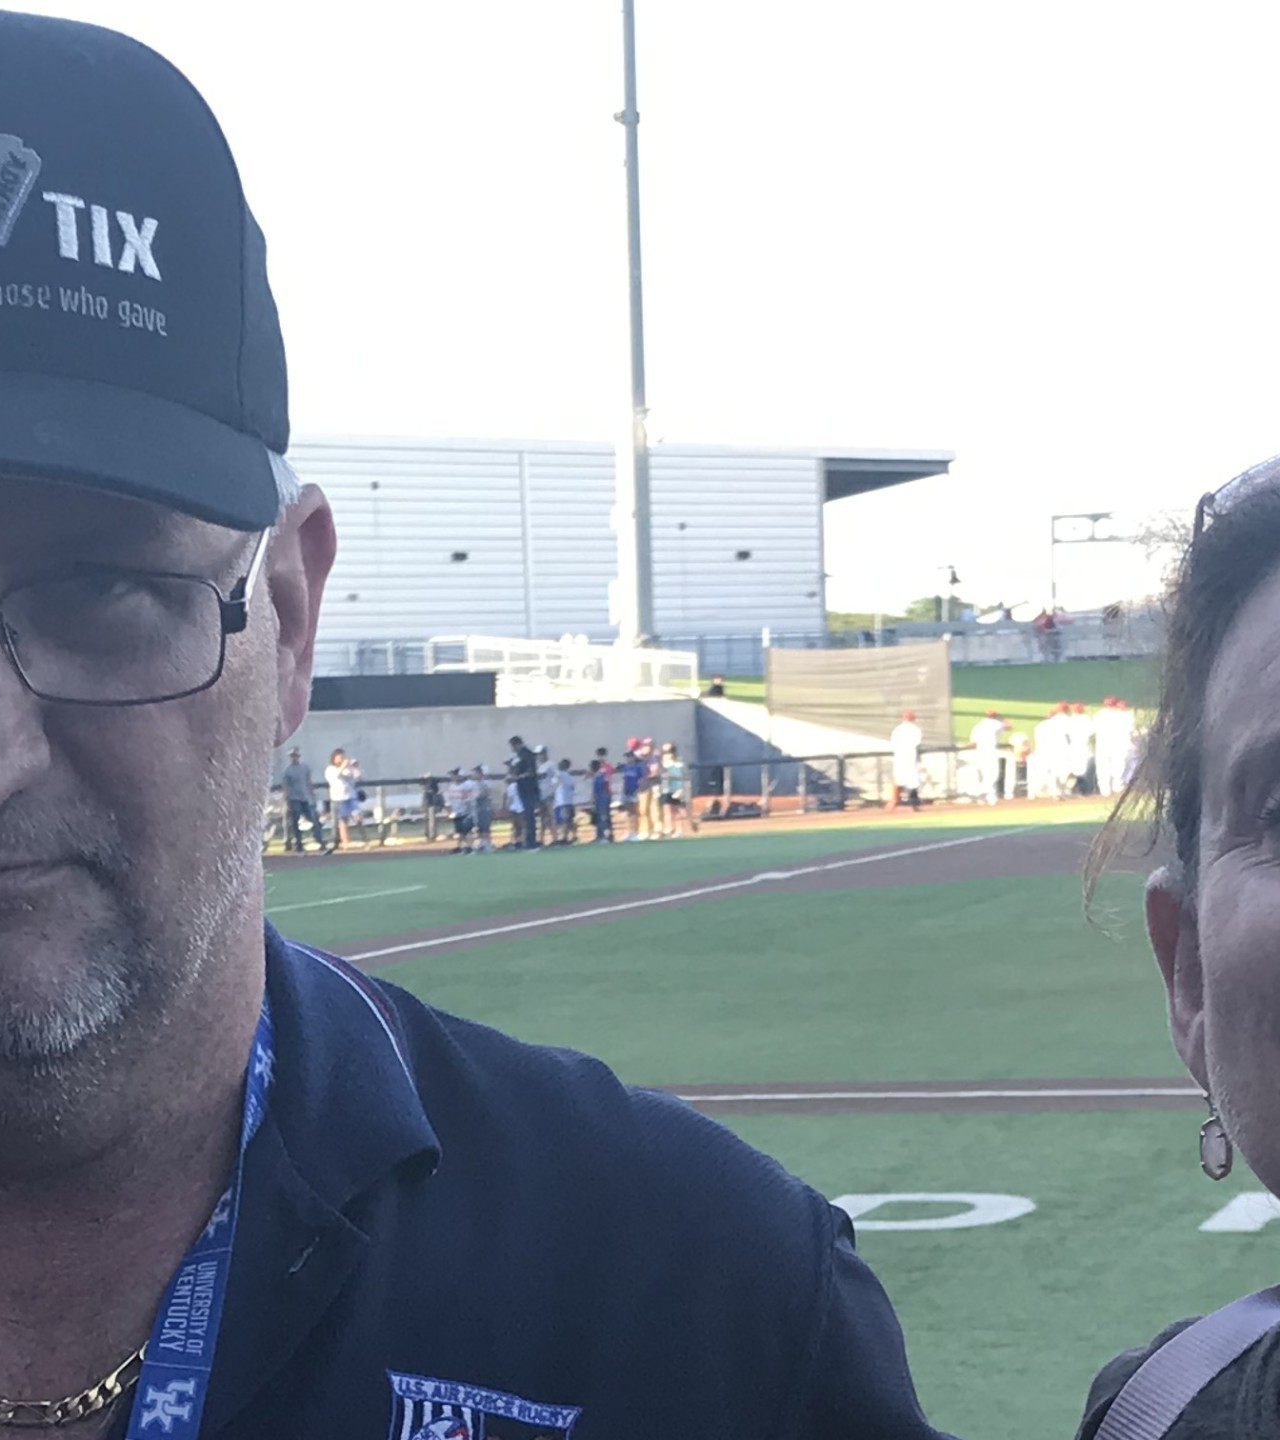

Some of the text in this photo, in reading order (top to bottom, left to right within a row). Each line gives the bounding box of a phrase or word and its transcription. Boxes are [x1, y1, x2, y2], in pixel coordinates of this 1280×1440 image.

[43, 191, 162, 281] TIX
[59, 286, 108, 319] who
[118, 300, 167, 336] gave
[159, 1264, 196, 1352] KENTUCKY
[190, 1261, 218, 1337] UNIVERSITY
